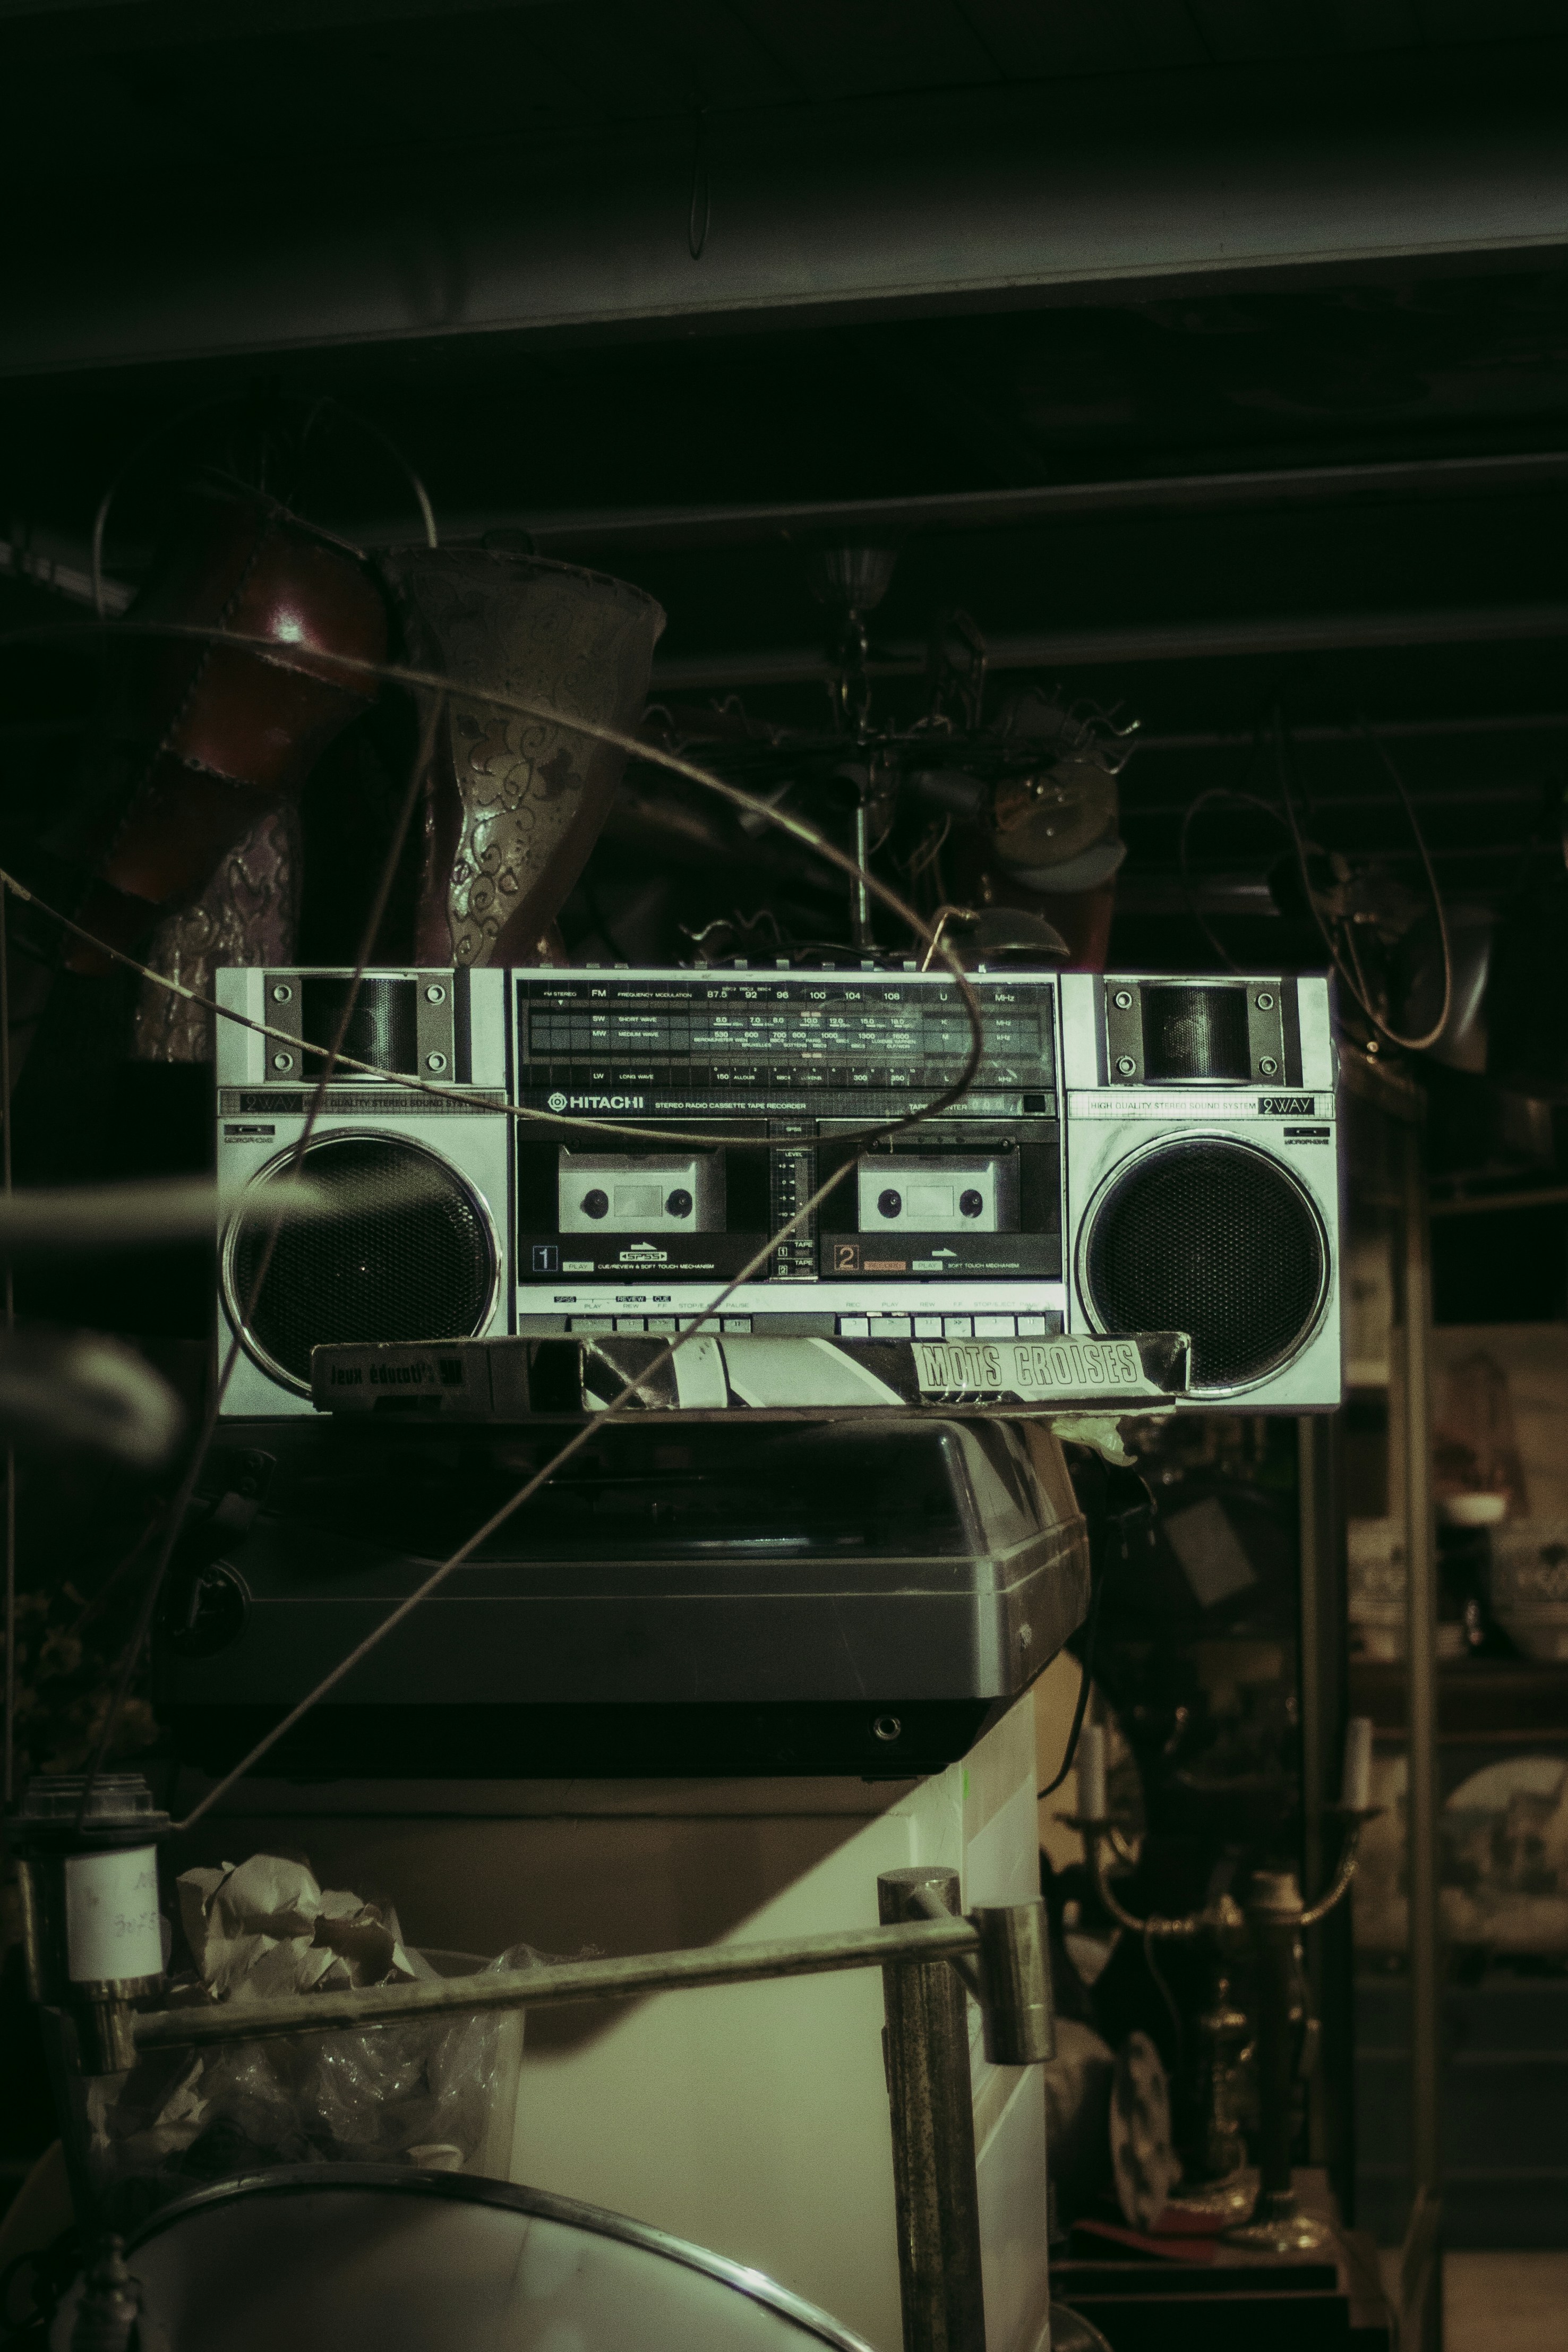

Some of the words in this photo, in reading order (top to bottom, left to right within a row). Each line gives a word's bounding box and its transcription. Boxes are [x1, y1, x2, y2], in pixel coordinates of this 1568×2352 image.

[330, 1099, 370, 1107] QUALITY
[372, 1099, 408, 1107] STEREO
[410, 1099, 443, 1107] SOUND
[570, 1096, 644, 1109] HITACHI
[1263, 1098, 1310, 1114] 2WAY
[538, 1248, 548, 1269] 1
[839, 1246, 855, 1269] 2
[331, 1364, 363, 1385] Jeux
[923, 1345, 1003, 1387] MOTS
[1013, 1343, 1138, 1386] CROISES
